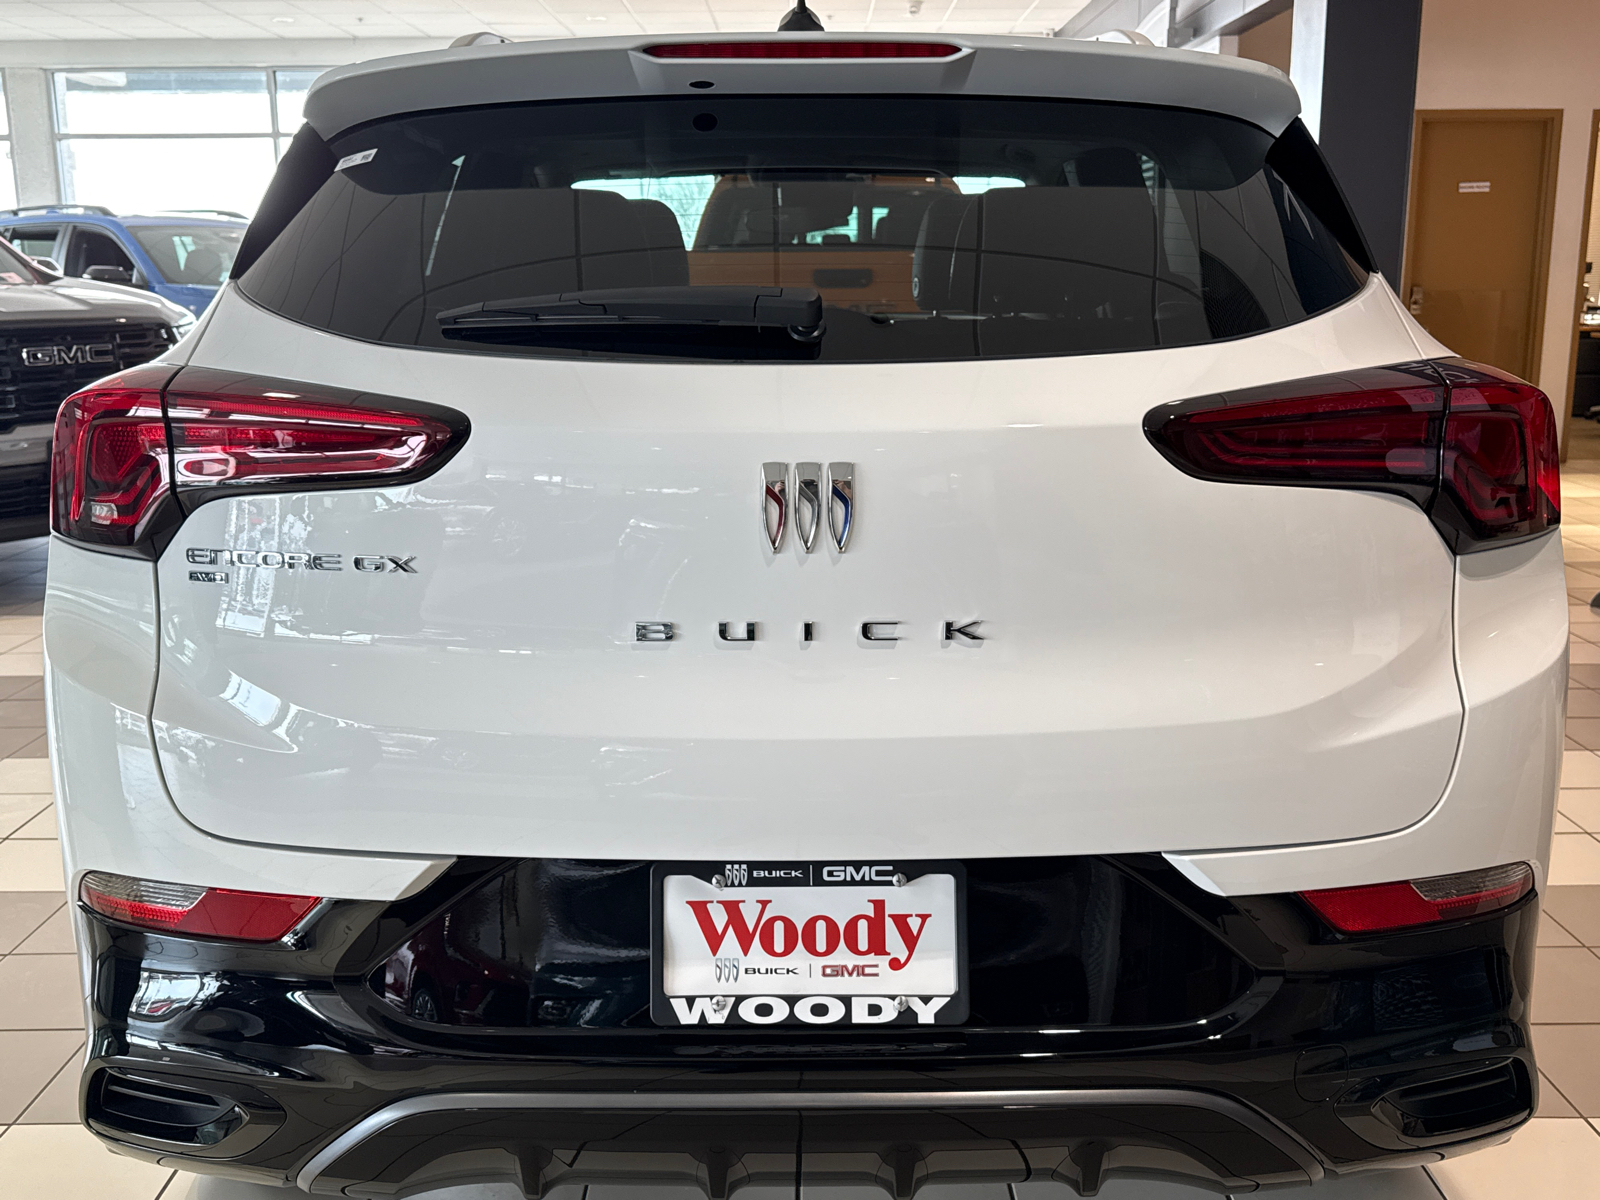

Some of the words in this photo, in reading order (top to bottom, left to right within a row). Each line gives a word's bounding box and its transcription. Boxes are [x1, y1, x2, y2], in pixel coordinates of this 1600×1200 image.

[22, 343, 114, 366] GMC
[186, 548, 343, 571] ENCORE
[353, 555, 418, 574] GX
[189, 571, 229, 584] AWD
[635, 620, 985, 642] BUICK
[753, 869, 803, 878] BUICK
[822, 865, 894, 881] GMC
[686, 899, 932, 971] Woody
[744, 967, 799, 975] BUICK
[821, 963, 880, 978] GMC
[669, 996, 951, 1025] WOODY
